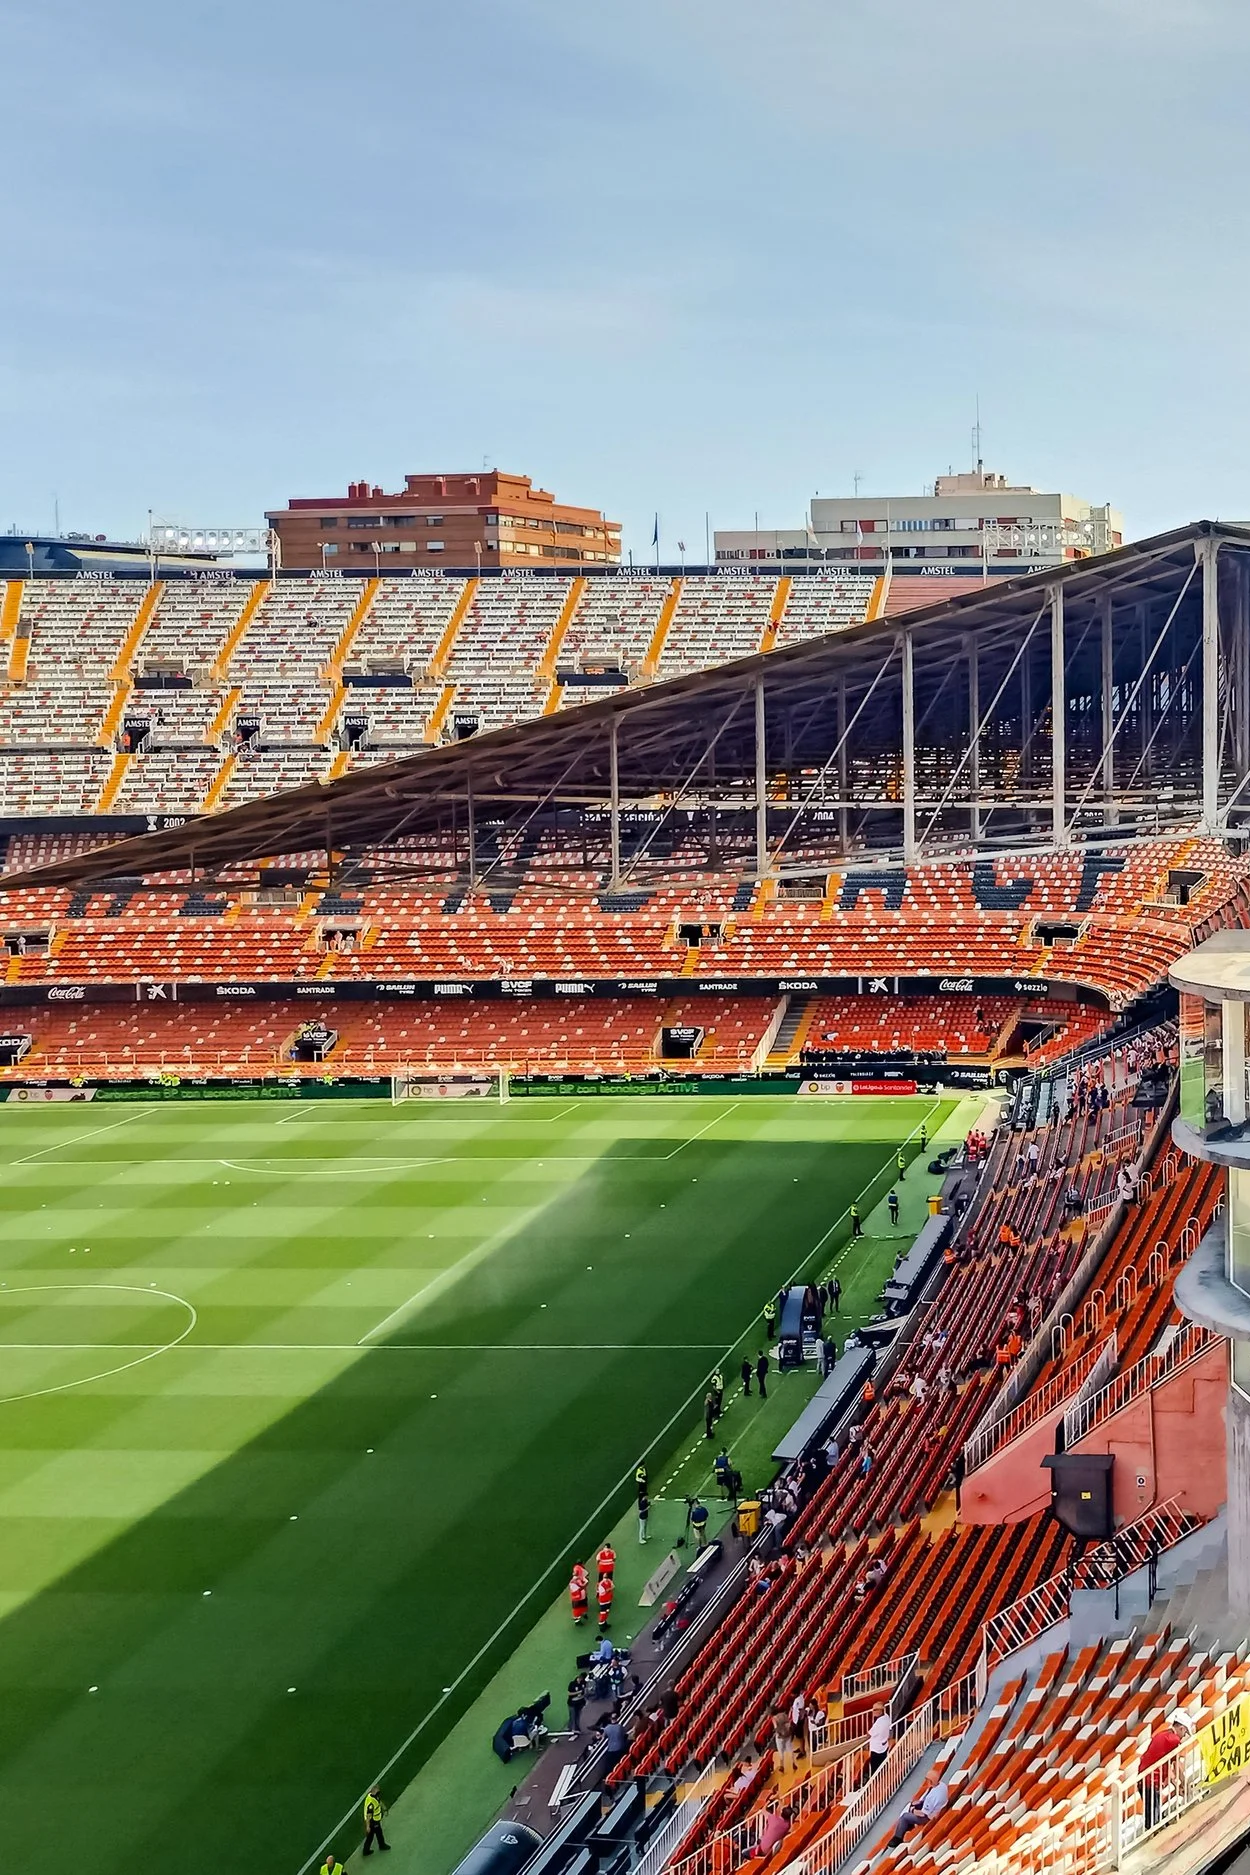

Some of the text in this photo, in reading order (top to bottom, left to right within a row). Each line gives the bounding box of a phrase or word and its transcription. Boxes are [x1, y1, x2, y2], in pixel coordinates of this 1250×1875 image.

[75, 570, 115, 579] AMSTEL
[309, 570, 345, 578] AMSTEL
[411, 569, 446, 577] AMSTEL
[501, 569, 536, 577] AMSTEL
[616, 568, 651, 576] AMSTEL
[717, 567, 752, 576] AMSTEL
[816, 567, 852, 576] AMSTEL
[920, 567, 956, 575] AMSTEL
[434, 984, 464, 994] PUMA
[555, 983, 586, 993] PUMA
[778, 981, 819, 990] ŠKODA
[1023, 983, 1048, 992] sezzle
[216, 986, 257, 995] ŠKODA
[261, 1087, 302, 1097] ACTIVE
[657, 1083, 699, 1093] ACTIVE
[1211, 1704, 1241, 1745] LIM
[1219, 1734, 1236, 1756] GO
